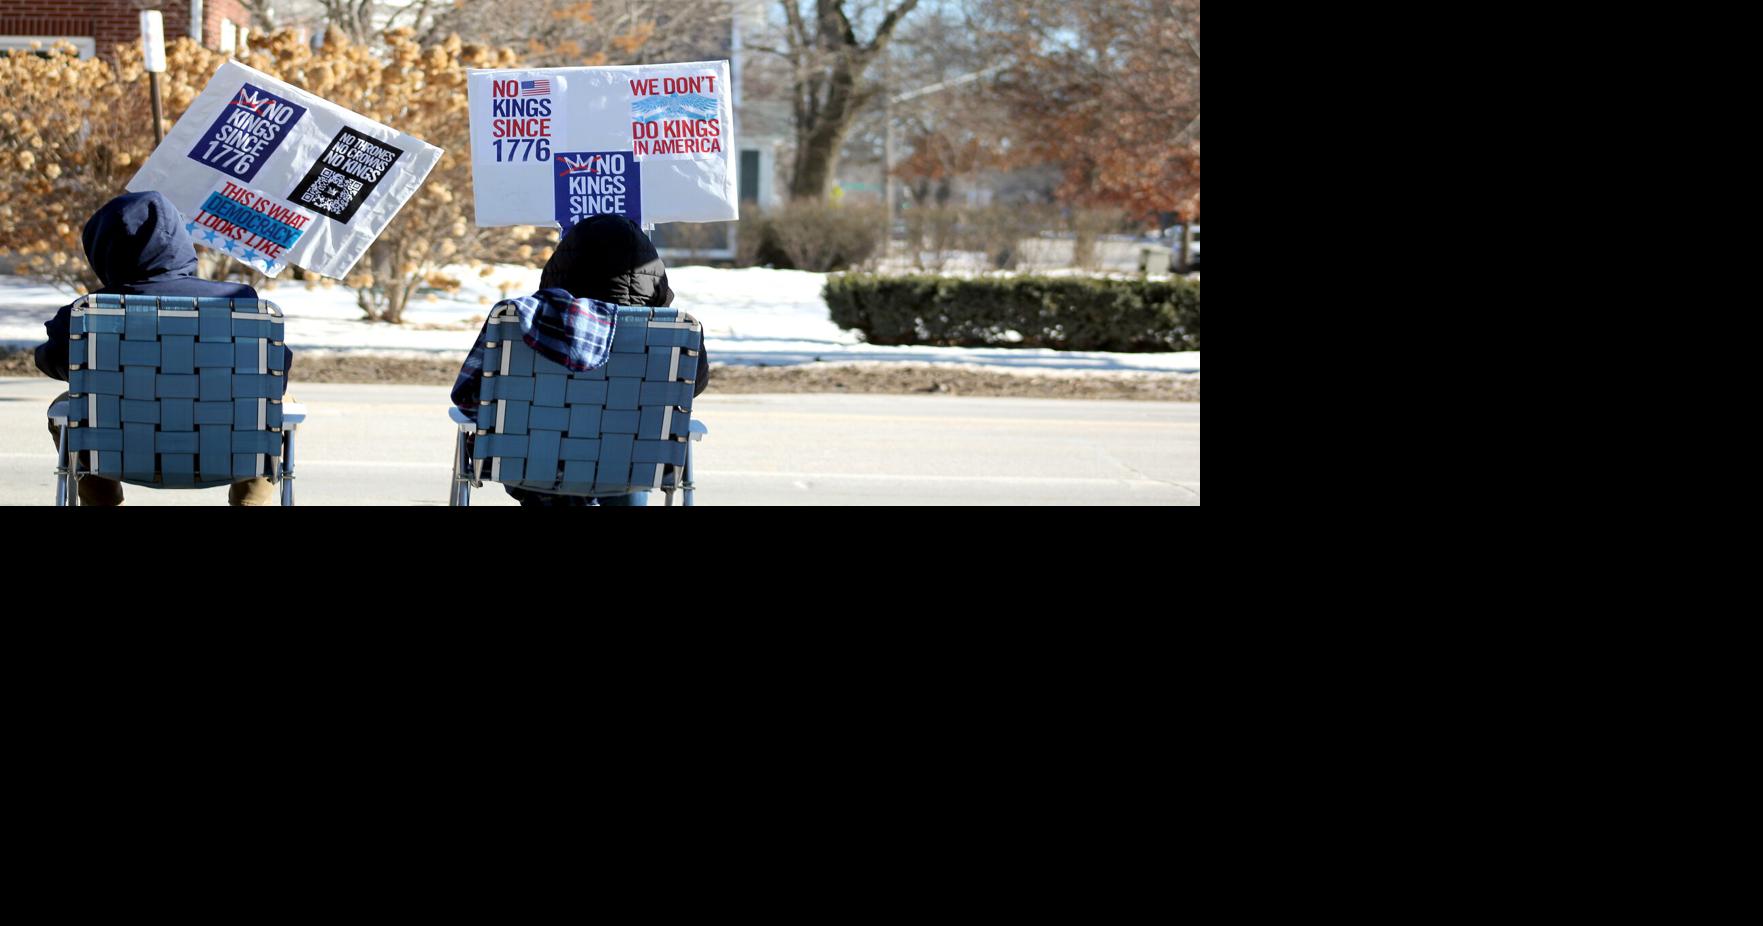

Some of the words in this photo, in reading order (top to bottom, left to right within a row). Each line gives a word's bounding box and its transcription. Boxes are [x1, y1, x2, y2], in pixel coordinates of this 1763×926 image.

[493, 79, 519, 98] NO
[629, 78, 660, 96] WE
[663, 75, 716, 95] DON'T
[261, 99, 294, 125] NO
[492, 98, 552, 118] KINGS
[226, 108, 281, 141] KINGS
[492, 118, 552, 138] SINCE
[632, 120, 659, 140] DO
[663, 118, 720, 139] KINGS
[215, 124, 269, 157] SINCE
[339, 132, 356, 146] NO
[353, 138, 396, 163] THRONES
[492, 138, 551, 162] 1776
[633, 140, 649, 155] IN
[652, 138, 721, 154] AMERICA
[202, 140, 255, 175] 1776
[322, 151, 345, 168] NO
[341, 160, 381, 183] KINGS
[331, 141, 348, 154] NO
[347, 148, 388, 172] CROWNS
[596, 153, 626, 175] NO
[569, 175, 626, 195] KINGS
[220, 181, 255, 206] THIS
[251, 196, 270, 215] IS
[268, 203, 310, 230] WHAT
[569, 195, 626, 214] SINCE
[206, 195, 297, 244] DEMOCRACY
[194, 209, 248, 241] LOOKS
[244, 232, 286, 259] LIKE
